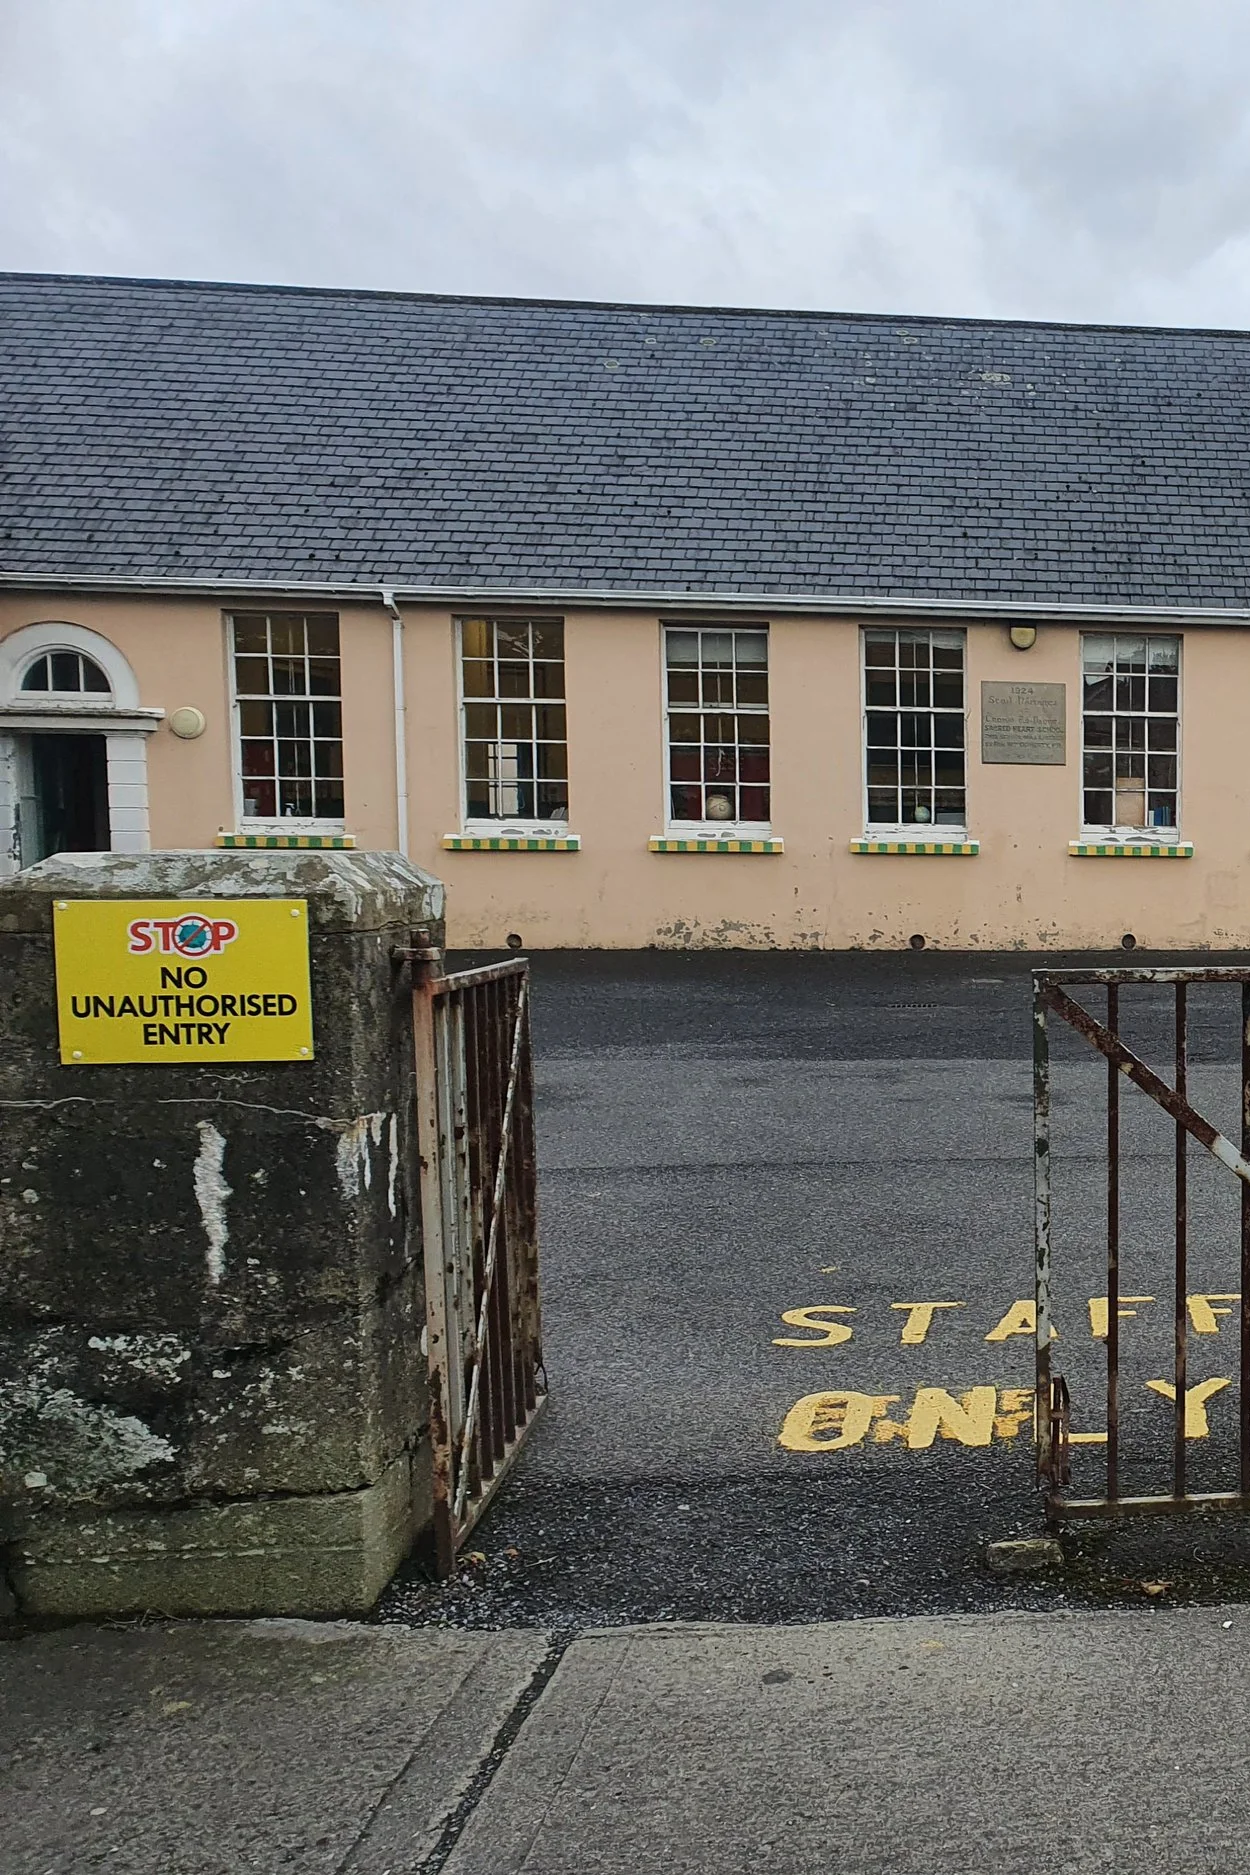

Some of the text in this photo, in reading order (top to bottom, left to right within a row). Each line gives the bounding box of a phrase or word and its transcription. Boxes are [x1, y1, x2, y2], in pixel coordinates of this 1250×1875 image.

[129, 915, 236, 957] STOP
[160, 966, 208, 989] NO
[71, 994, 297, 1018] UNAUTHORISED
[143, 1022, 231, 1046] ENTRY
[771, 1293, 1243, 1348] STAFF
[777, 1377, 1232, 1452] ONLY
